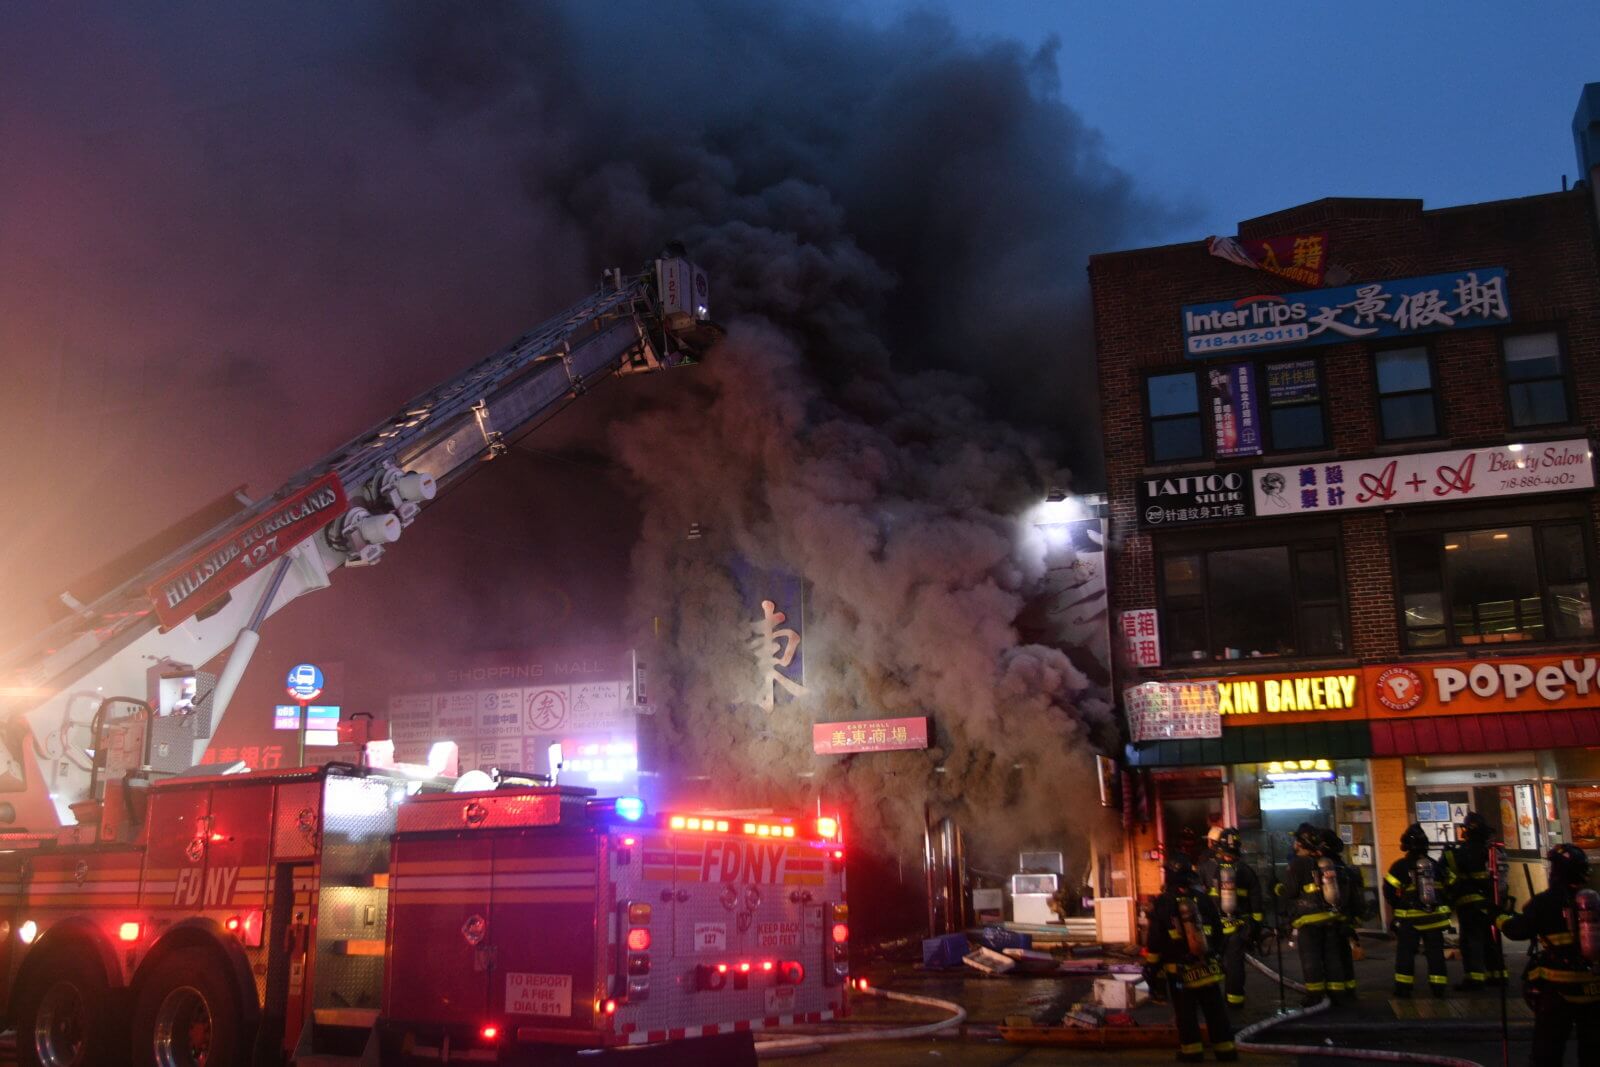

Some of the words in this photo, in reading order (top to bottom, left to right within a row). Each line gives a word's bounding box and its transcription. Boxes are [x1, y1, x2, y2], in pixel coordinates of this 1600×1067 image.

[1308, 272, 1506, 338] 文景假期
[1192, 327, 1304, 350] 718-412-0111
[1541, 446, 1585, 467] Salon
[1144, 472, 1242, 497] TATTOO
[1354, 461, 1397, 503] A
[1432, 454, 1476, 497] A
[1194, 491, 1242, 504] STUDIO
[162, 541, 240, 608] HILLSIDE
[241, 484, 337, 549] HURRICANES
[241, 535, 279, 569] 127
[448, 664, 544, 681] SHOPPING
[554, 661, 605, 675] MALL
[1264, 675, 1357, 713] BAKERY
[832, 726, 907, 746] 美東商場
[1455, 806, 1464, 816] A
[701, 840, 787, 884] FDNY
[174, 866, 239, 905] FDNY
[758, 922, 778, 934] KEEP
[780, 922, 800, 933] BACK
[704, 934, 716, 944] 127
[762, 935, 778, 946] 200
[779, 934, 796, 945] FEET
[510, 975, 523, 986] TO
[526, 976, 568, 987] REPORT
[532, 989, 555, 1000] FIRE
[514, 1001, 537, 1012] DIAL
[541, 1003, 561, 1014] 911
